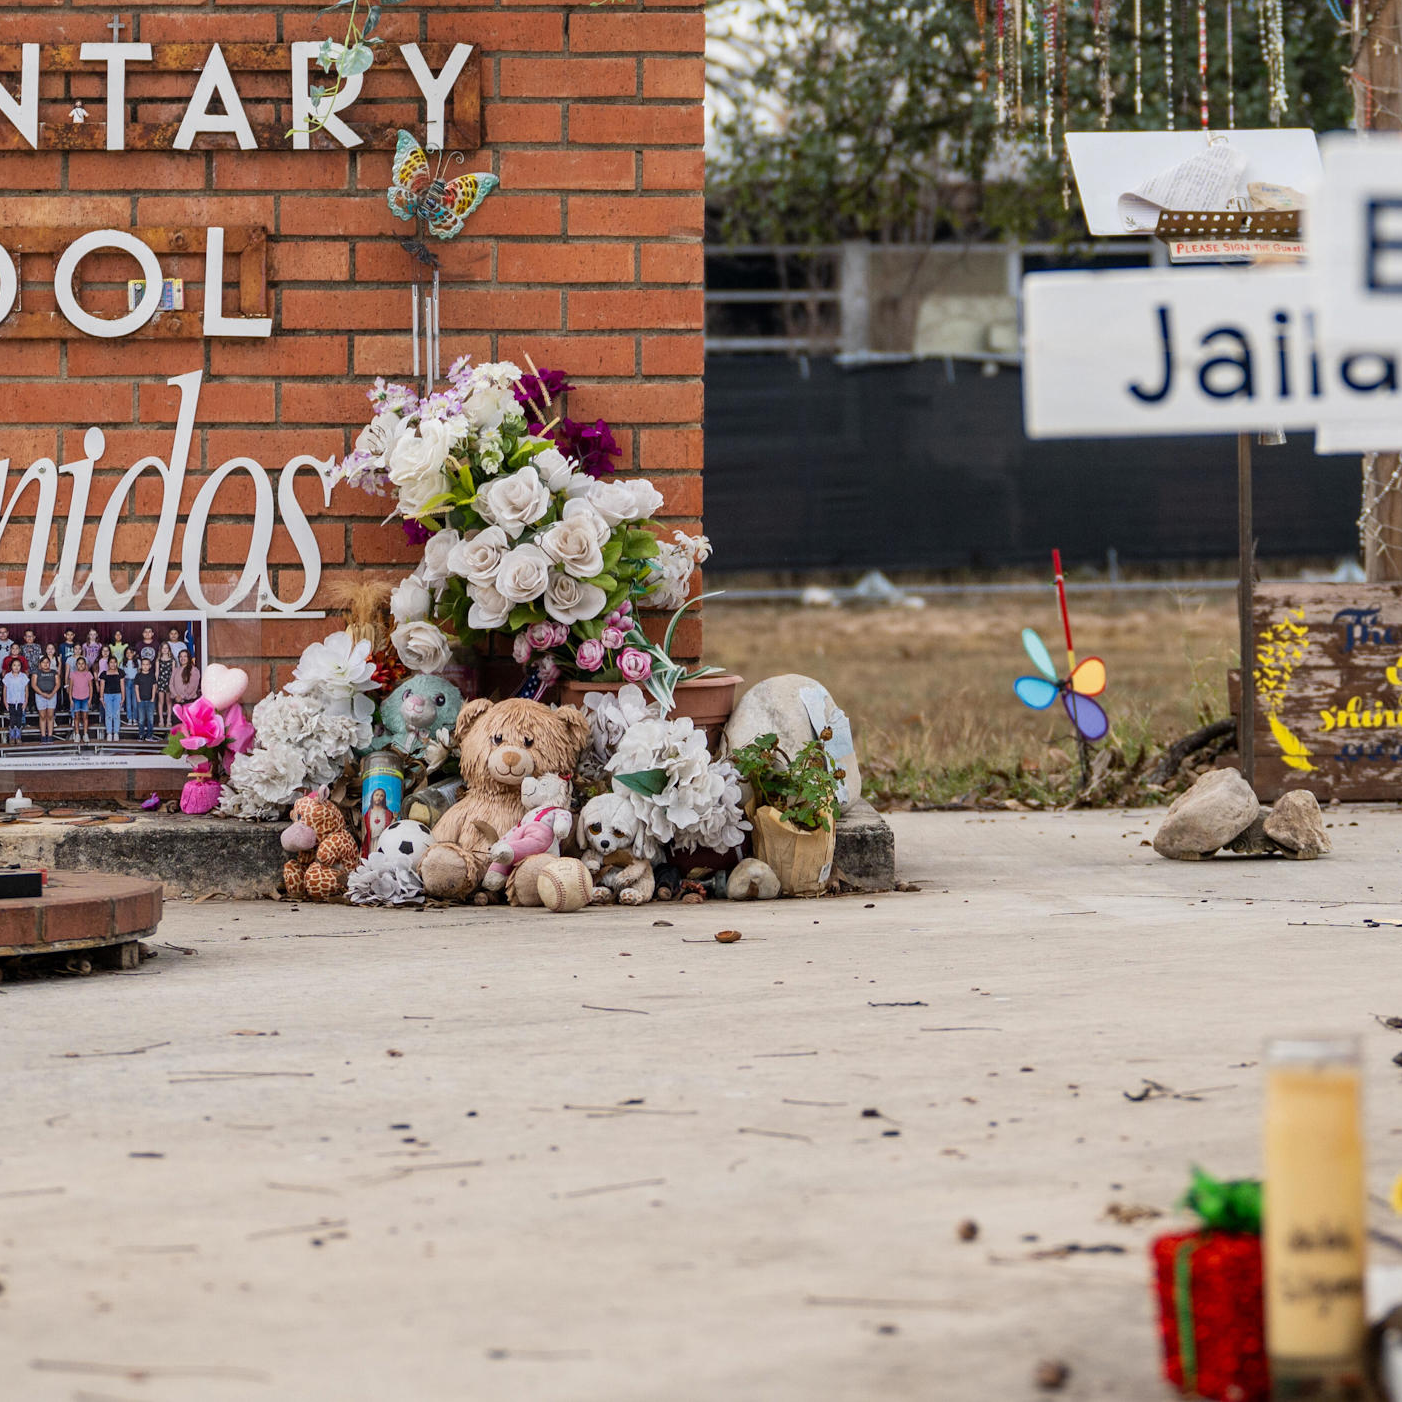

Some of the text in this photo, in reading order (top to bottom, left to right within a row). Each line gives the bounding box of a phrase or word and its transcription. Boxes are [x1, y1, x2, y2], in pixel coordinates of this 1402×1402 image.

[1176, 243, 1220, 254] PLEASE
[1223, 242, 1251, 253] SIGN
[1333, 603, 1397, 654] The
